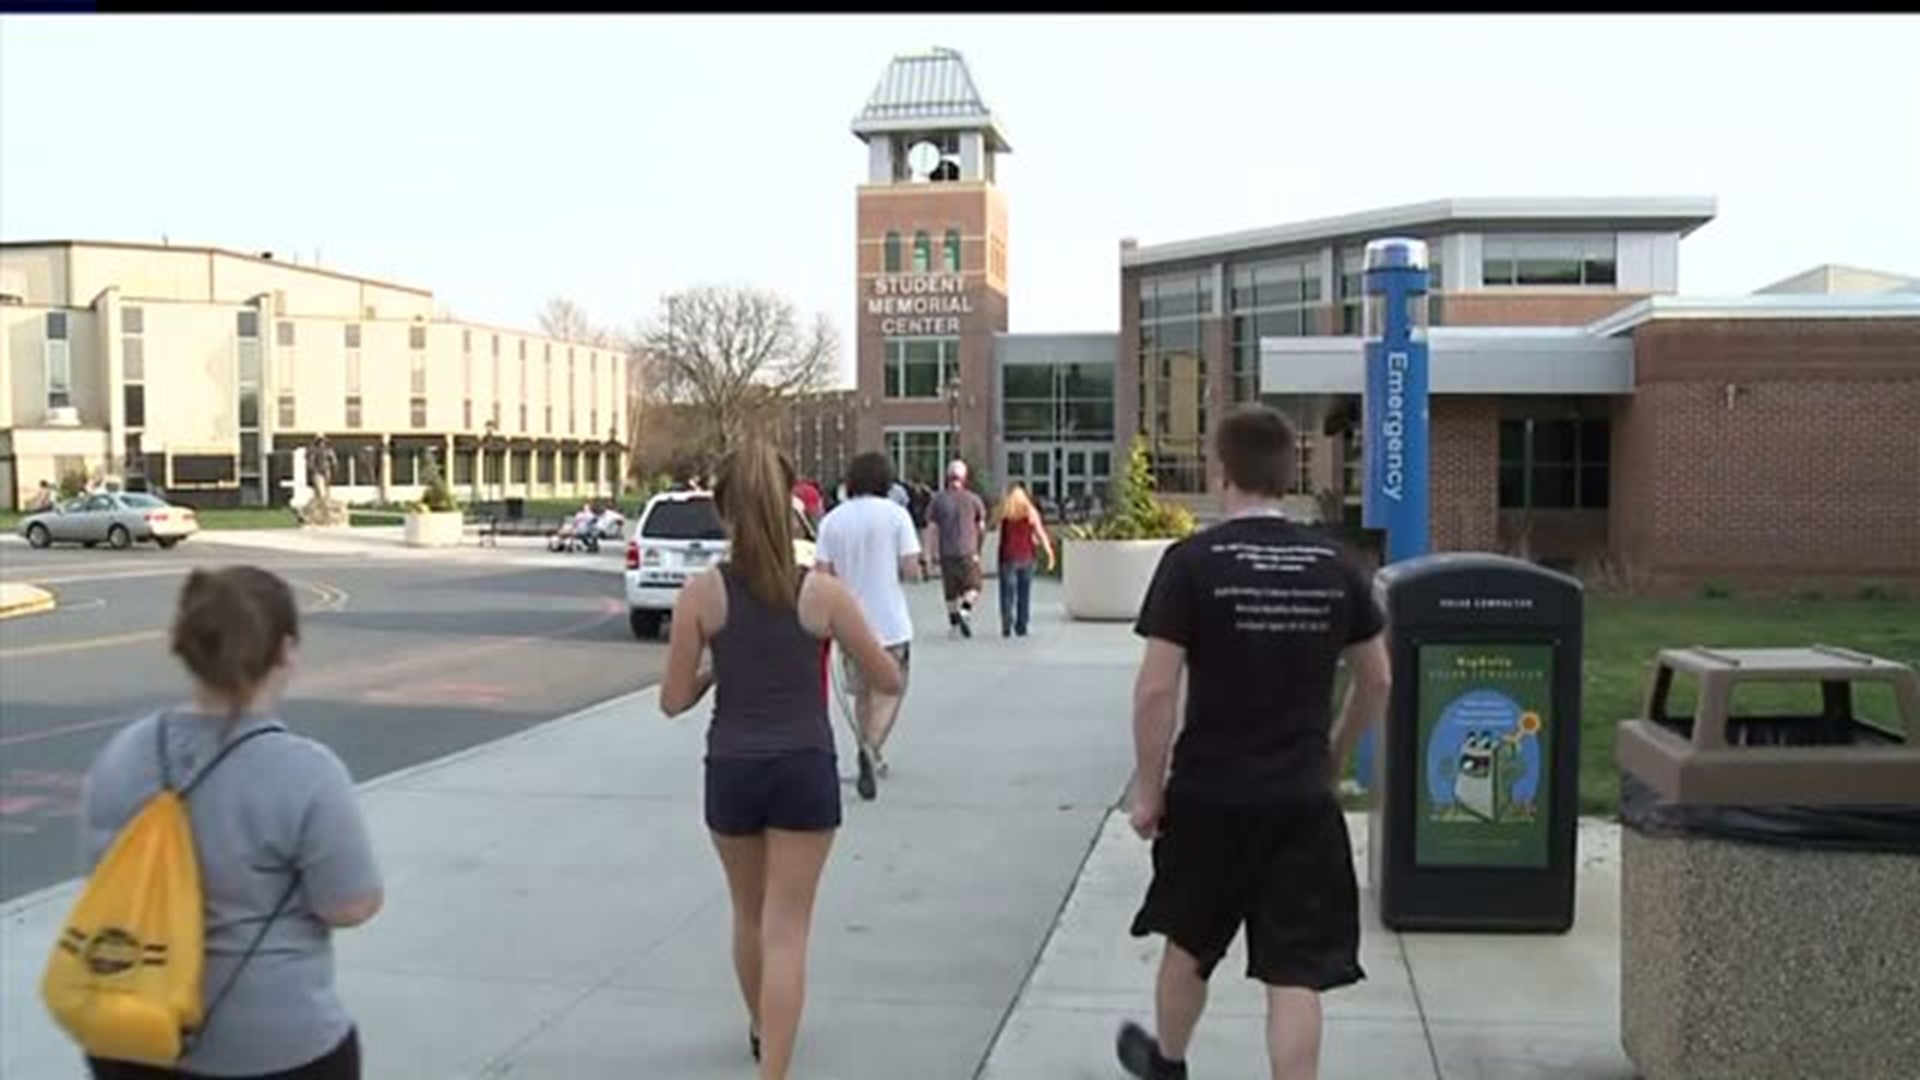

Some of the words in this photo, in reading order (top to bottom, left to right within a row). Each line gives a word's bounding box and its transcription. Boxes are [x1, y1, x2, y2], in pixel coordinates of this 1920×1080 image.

[875, 276, 964, 294] STUDENT
[868, 296, 973, 314] MEMORIAL
[881, 316, 960, 334] CENTER
[1383, 352, 1408, 501] Emergency
